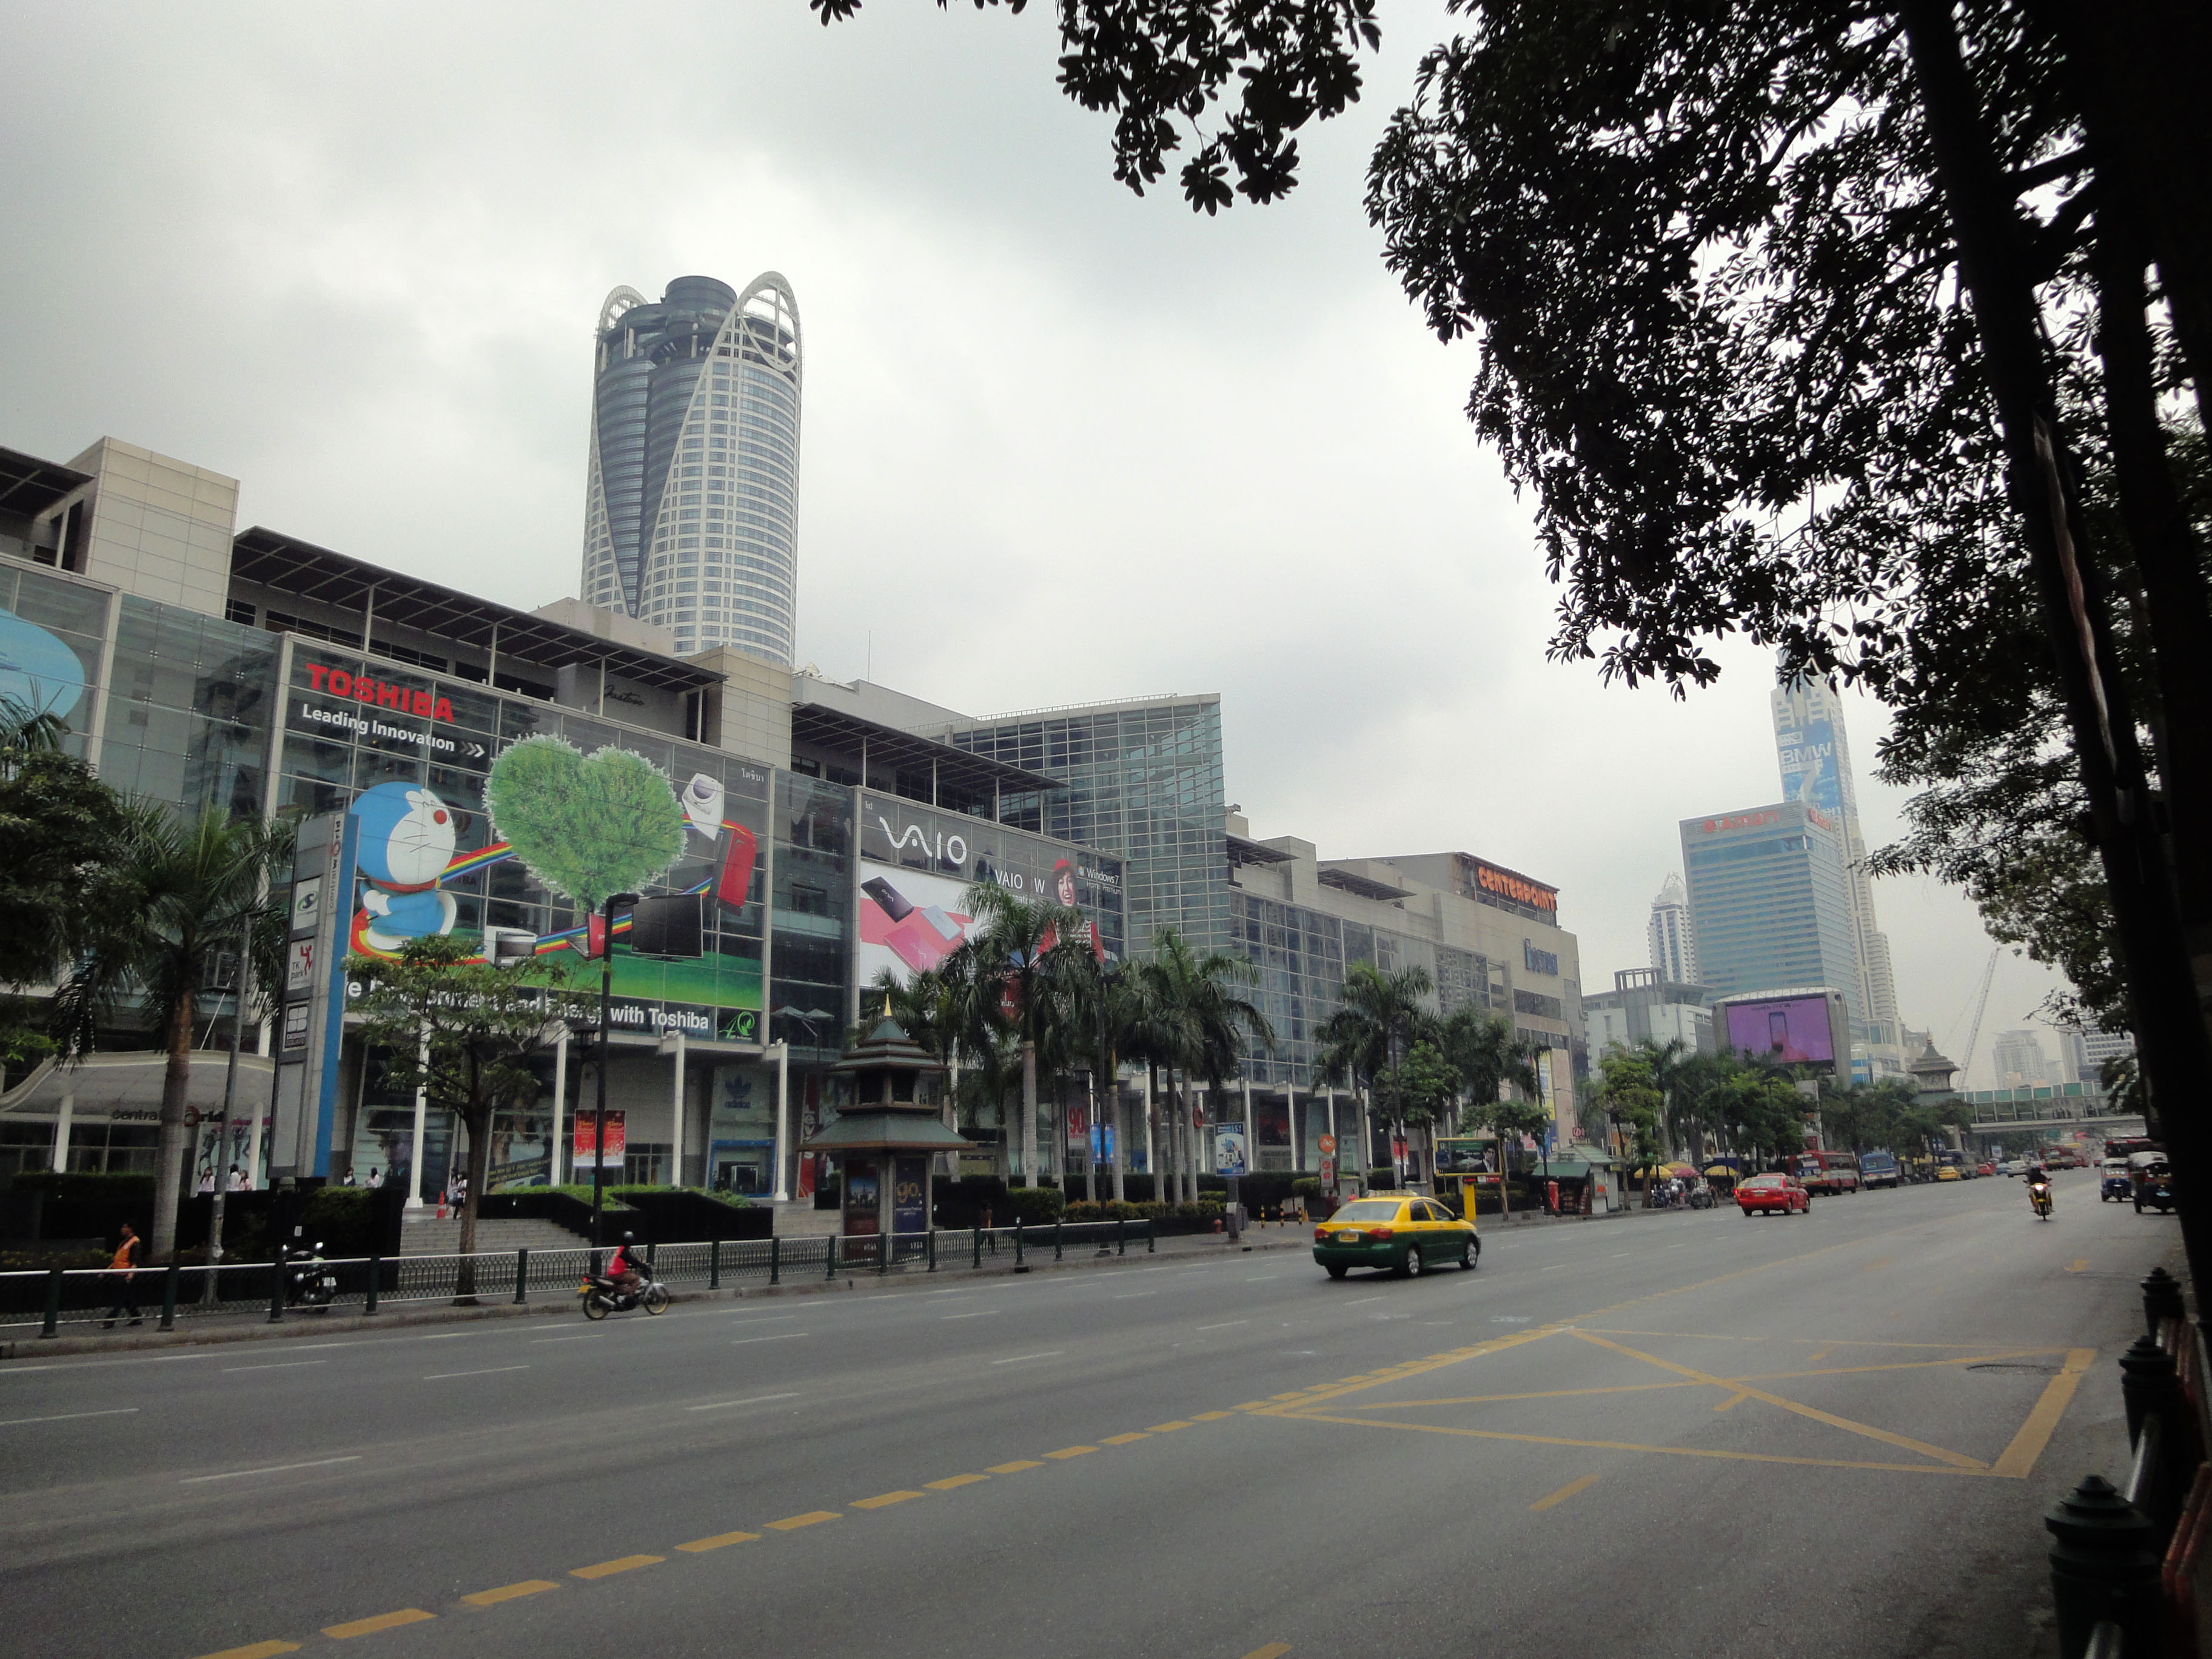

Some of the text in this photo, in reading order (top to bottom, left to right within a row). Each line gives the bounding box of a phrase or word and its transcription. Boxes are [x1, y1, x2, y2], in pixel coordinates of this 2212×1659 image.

[306, 663, 454, 723] TOSHIBA
[303, 703, 455, 752] Leading Innovation
[1780, 742, 1832, 766] BMW
[1720, 809, 1778, 831] Amari
[879, 816, 967, 865] VAIO
[994, 869, 1045, 894] VAIO W
[1087, 867, 1115, 883] Windows
[1478, 866, 1556, 912] CENTERPOINT
[610, 1005, 645, 1025] with
[649, 1008, 709, 1030] Toshiba
